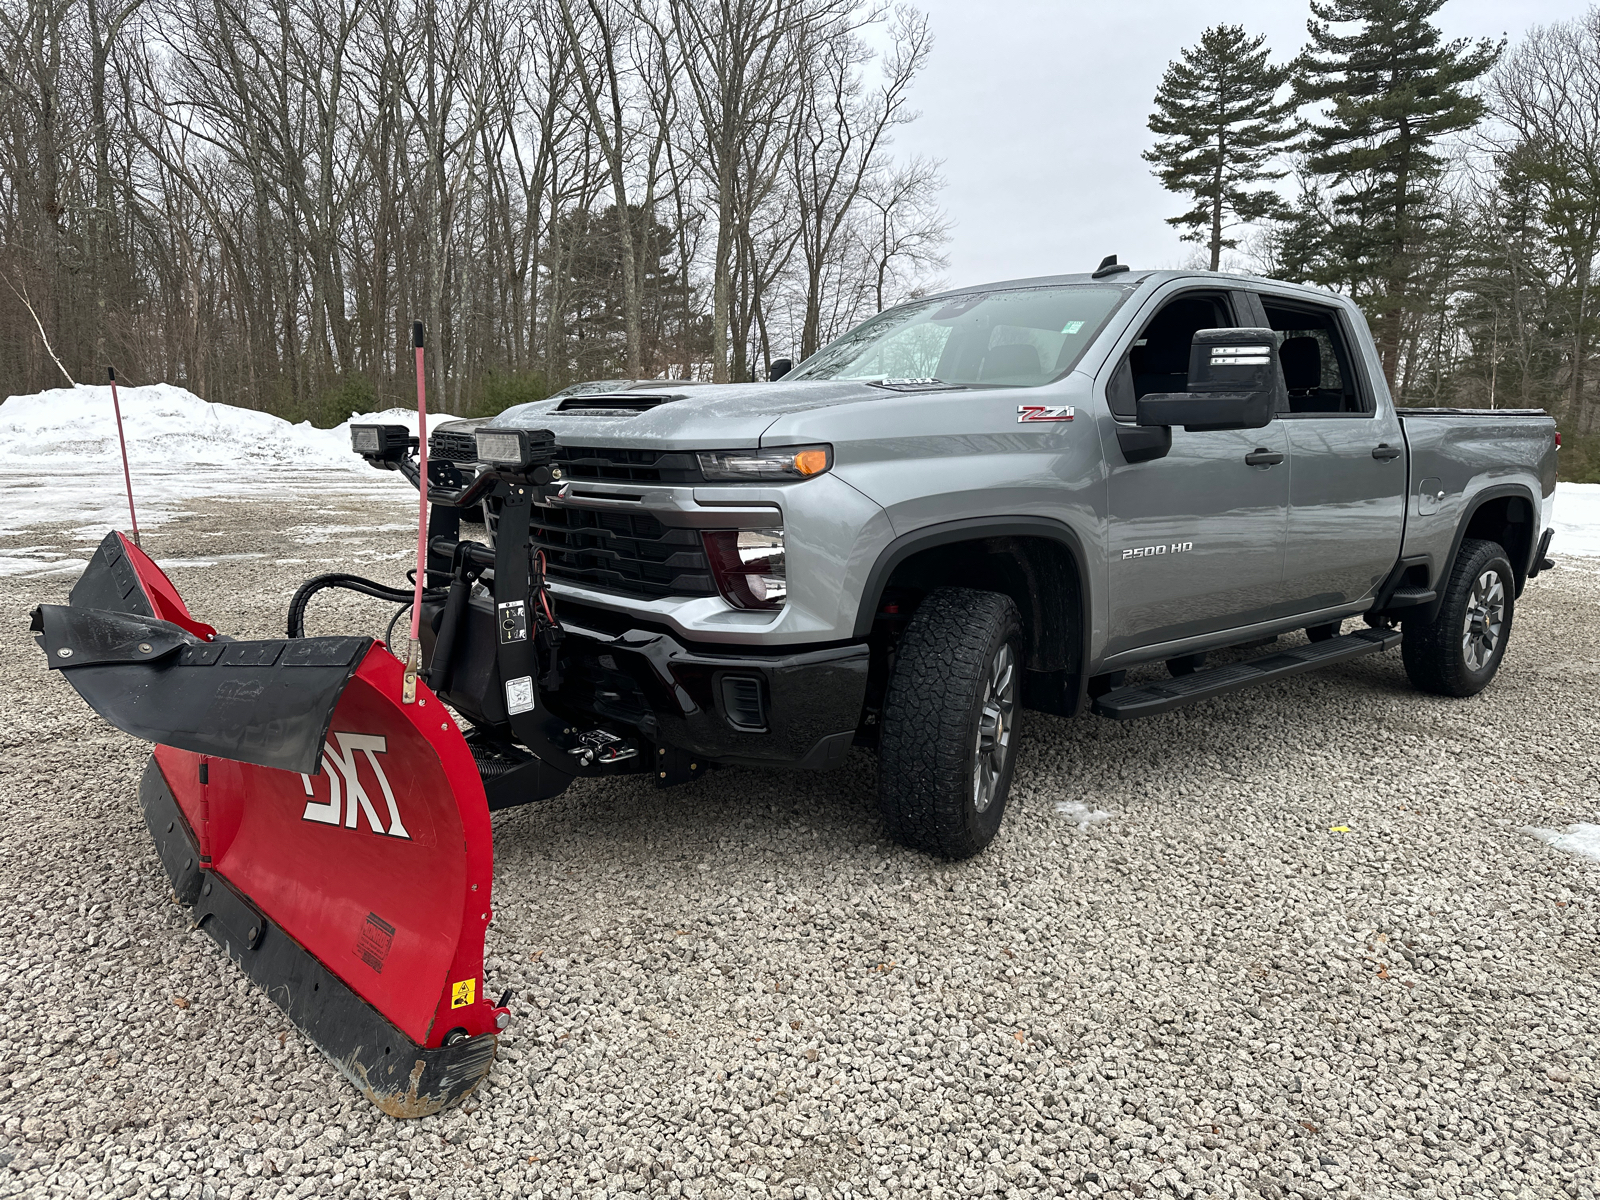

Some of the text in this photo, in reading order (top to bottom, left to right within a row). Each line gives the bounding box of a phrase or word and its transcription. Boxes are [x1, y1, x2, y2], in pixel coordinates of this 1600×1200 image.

[1017, 405, 1075, 423] Z71
[1122, 541, 1193, 560] 2500 HD
